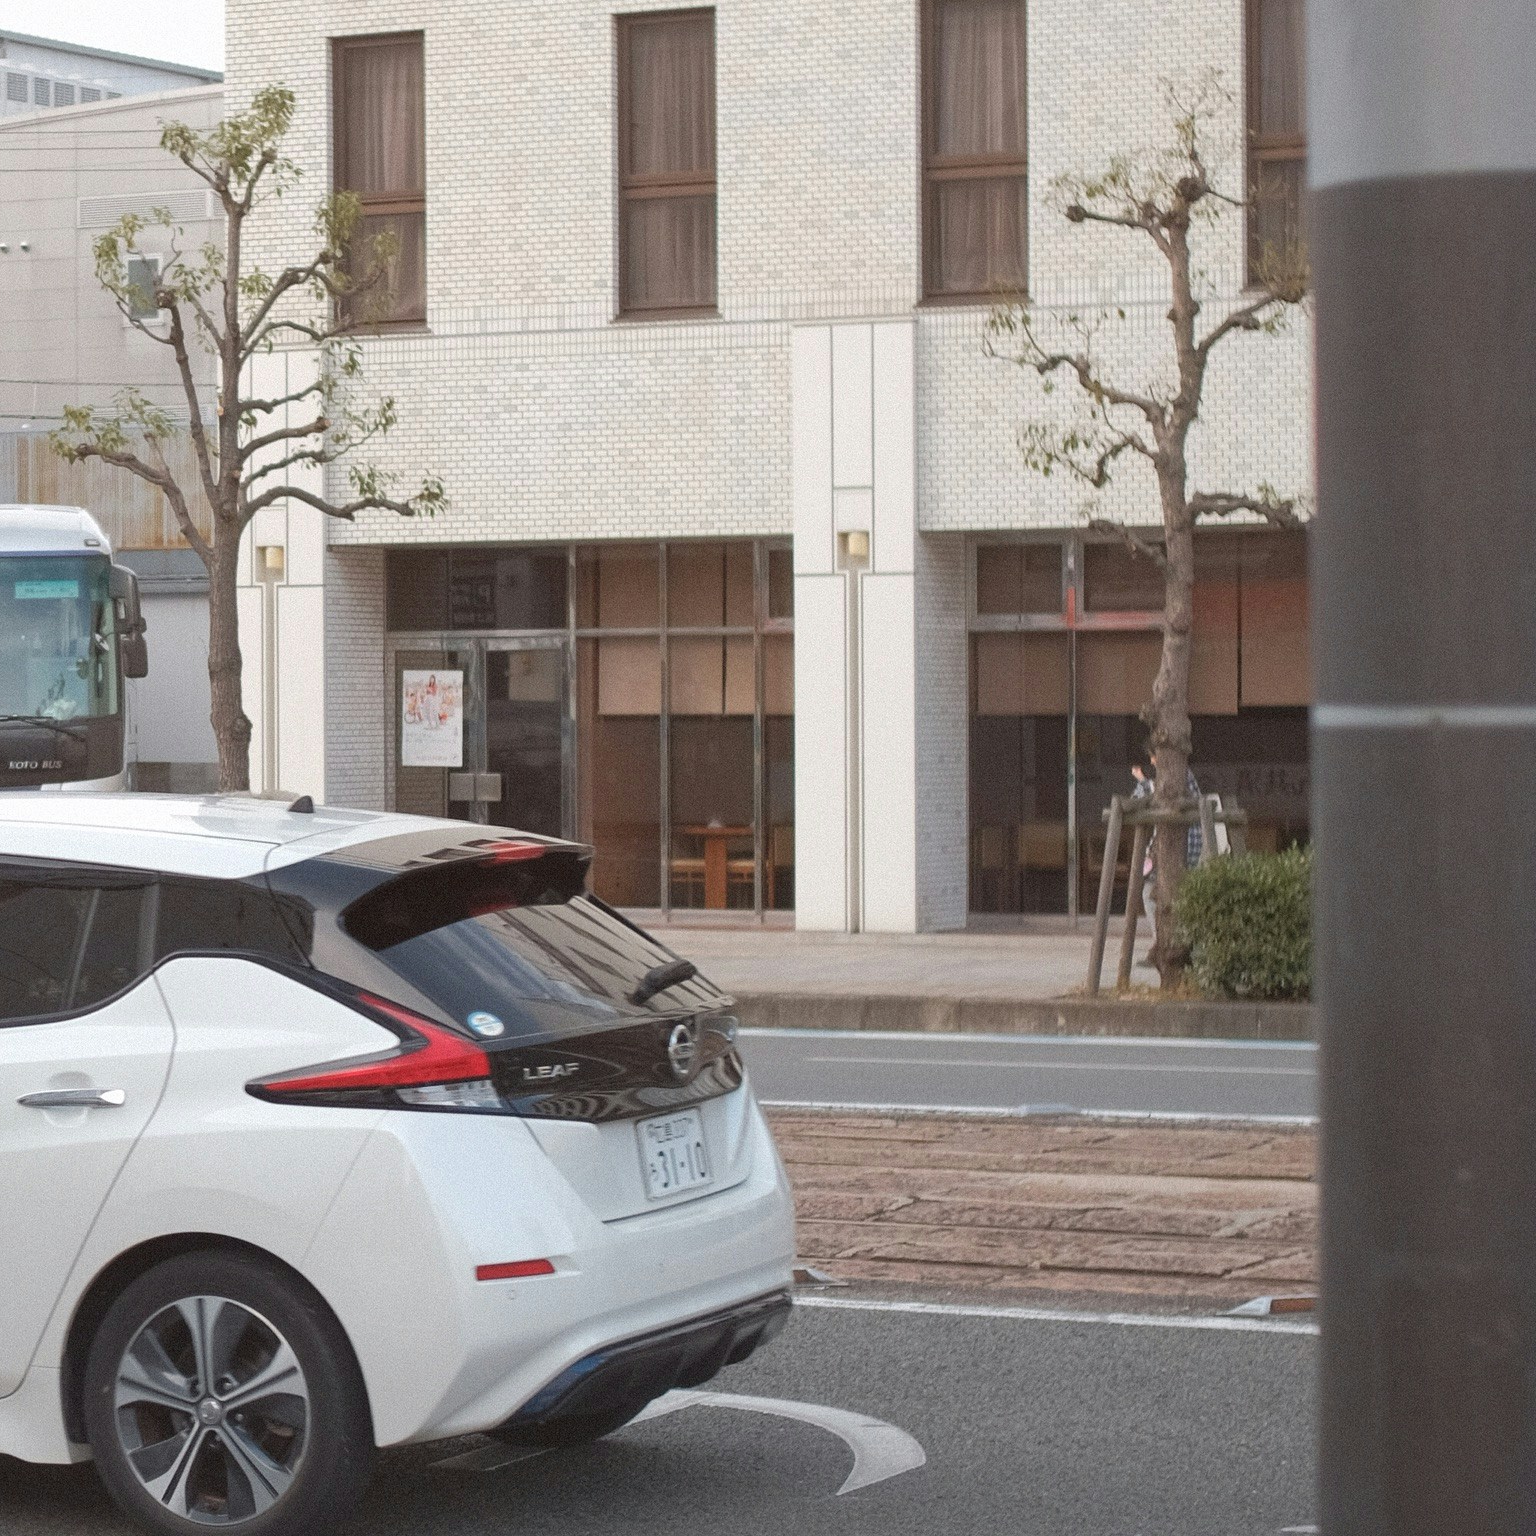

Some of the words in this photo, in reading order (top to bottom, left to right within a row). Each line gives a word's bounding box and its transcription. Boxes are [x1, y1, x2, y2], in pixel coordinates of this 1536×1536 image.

[42, 759, 63, 769] BUS
[523, 1062, 579, 1080] LEAF
[657, 1141, 708, 1189] 31-10
